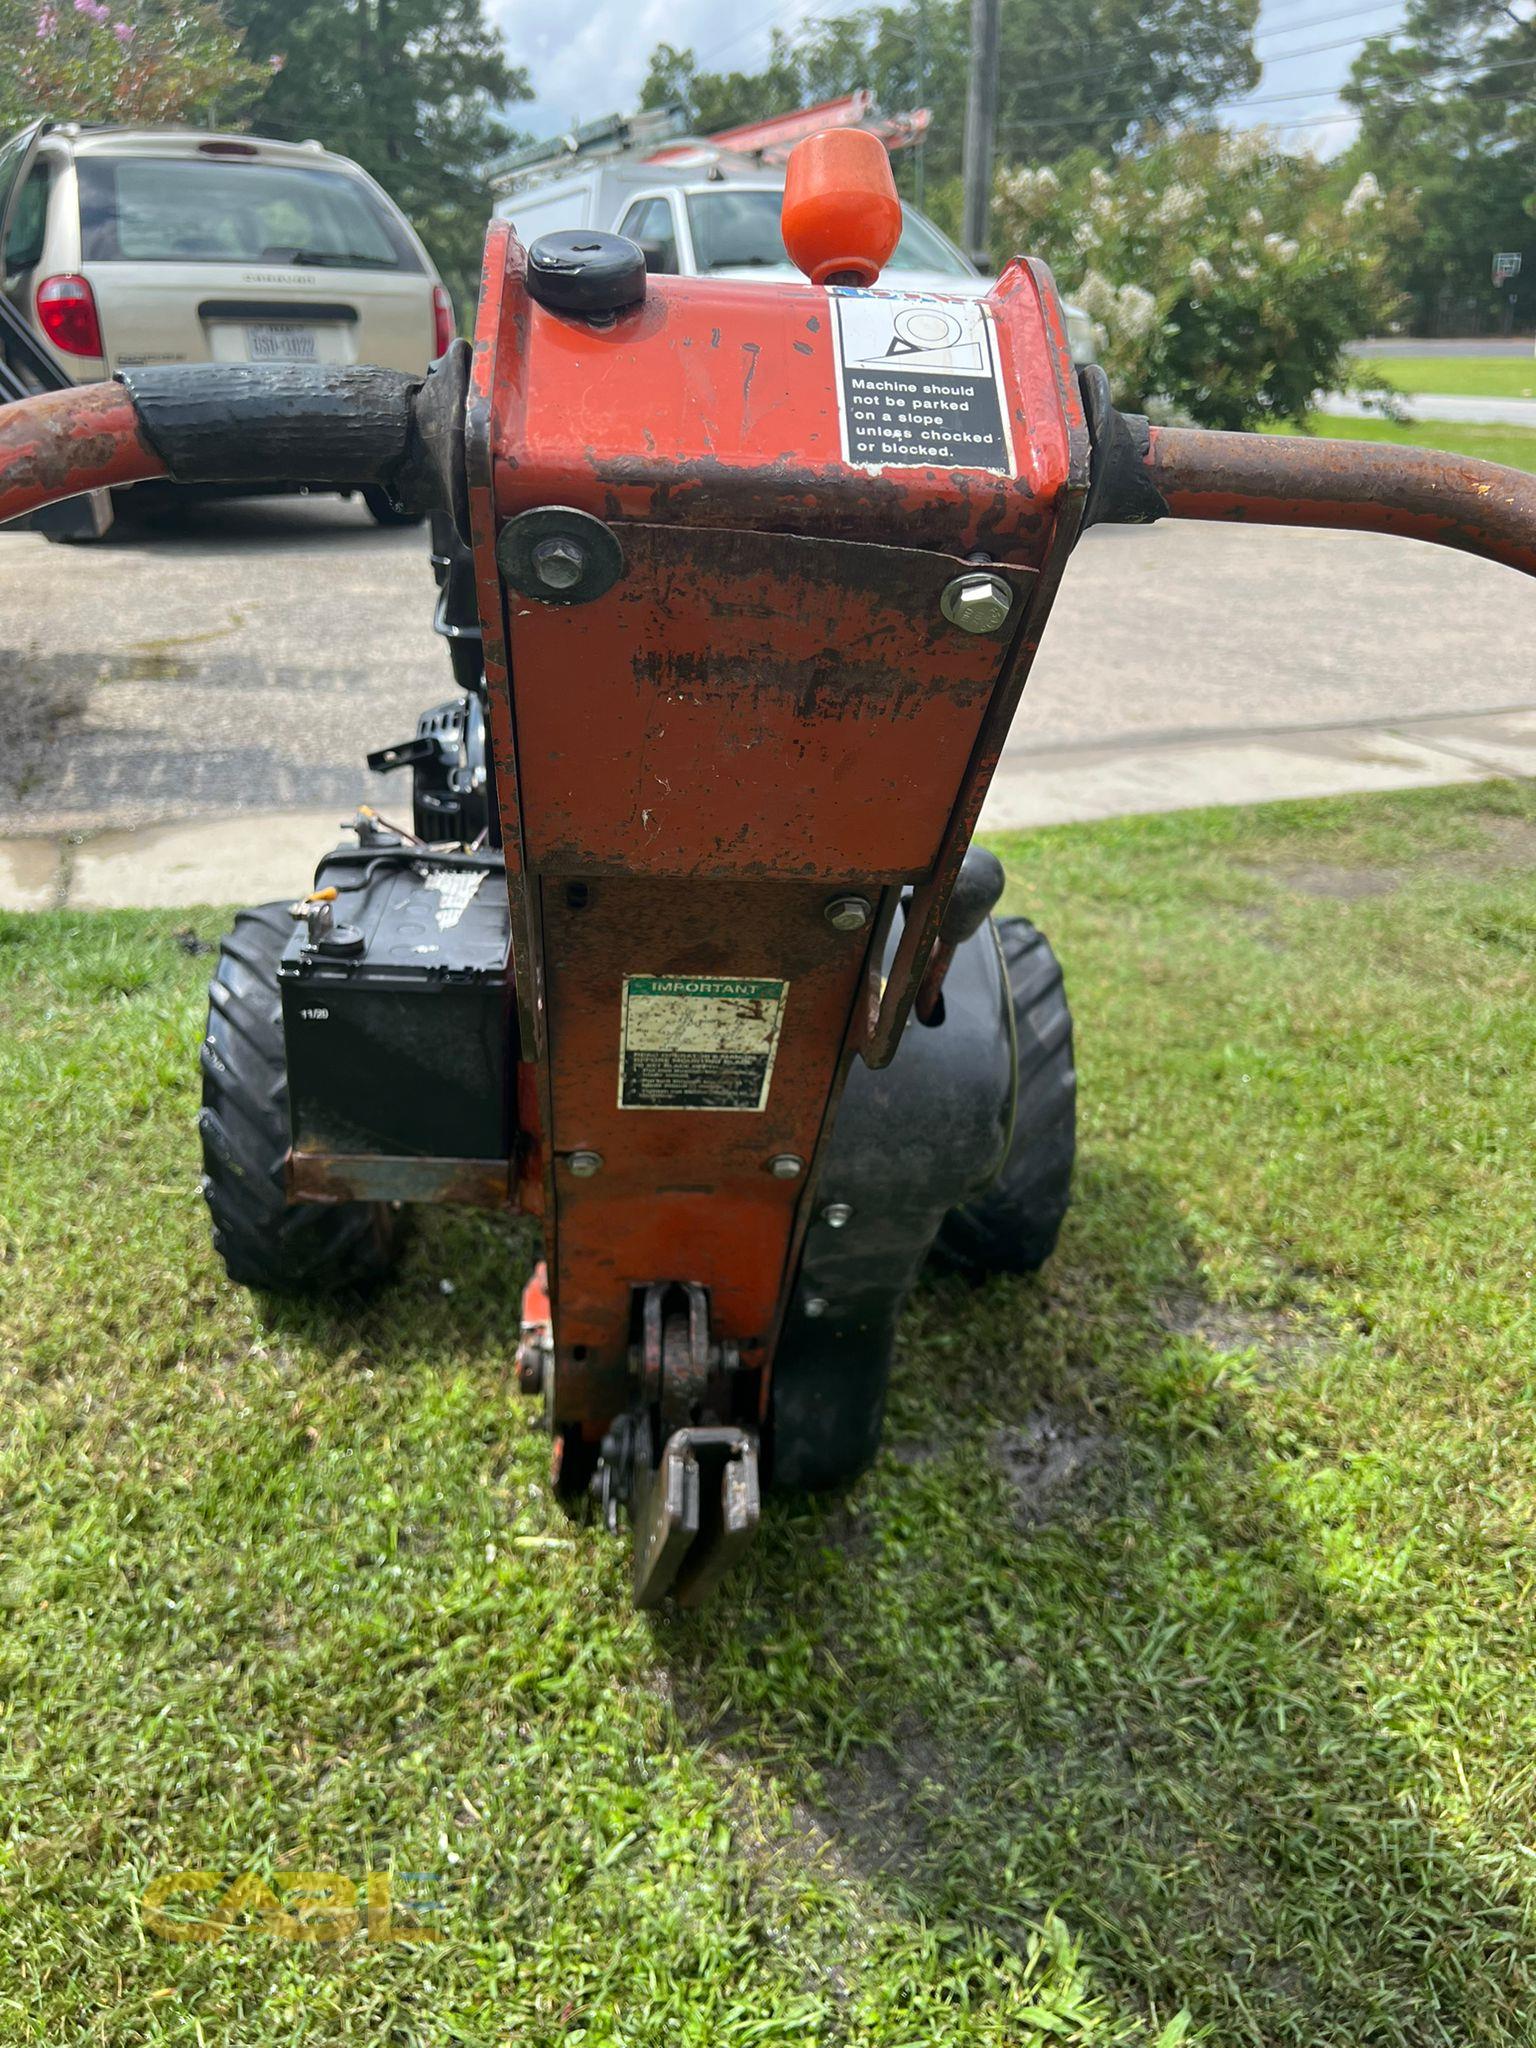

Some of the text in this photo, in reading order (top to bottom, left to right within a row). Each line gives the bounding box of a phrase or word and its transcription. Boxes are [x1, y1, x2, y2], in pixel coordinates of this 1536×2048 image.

[851, 378, 975, 397] Machine should
[853, 395, 970, 411] not be parked
[854, 411, 944, 426] on a slope
[855, 426, 994, 444] unless chocked
[856, 442, 954, 457] or blocked.
[651, 981, 760, 994] IMPORTANT
